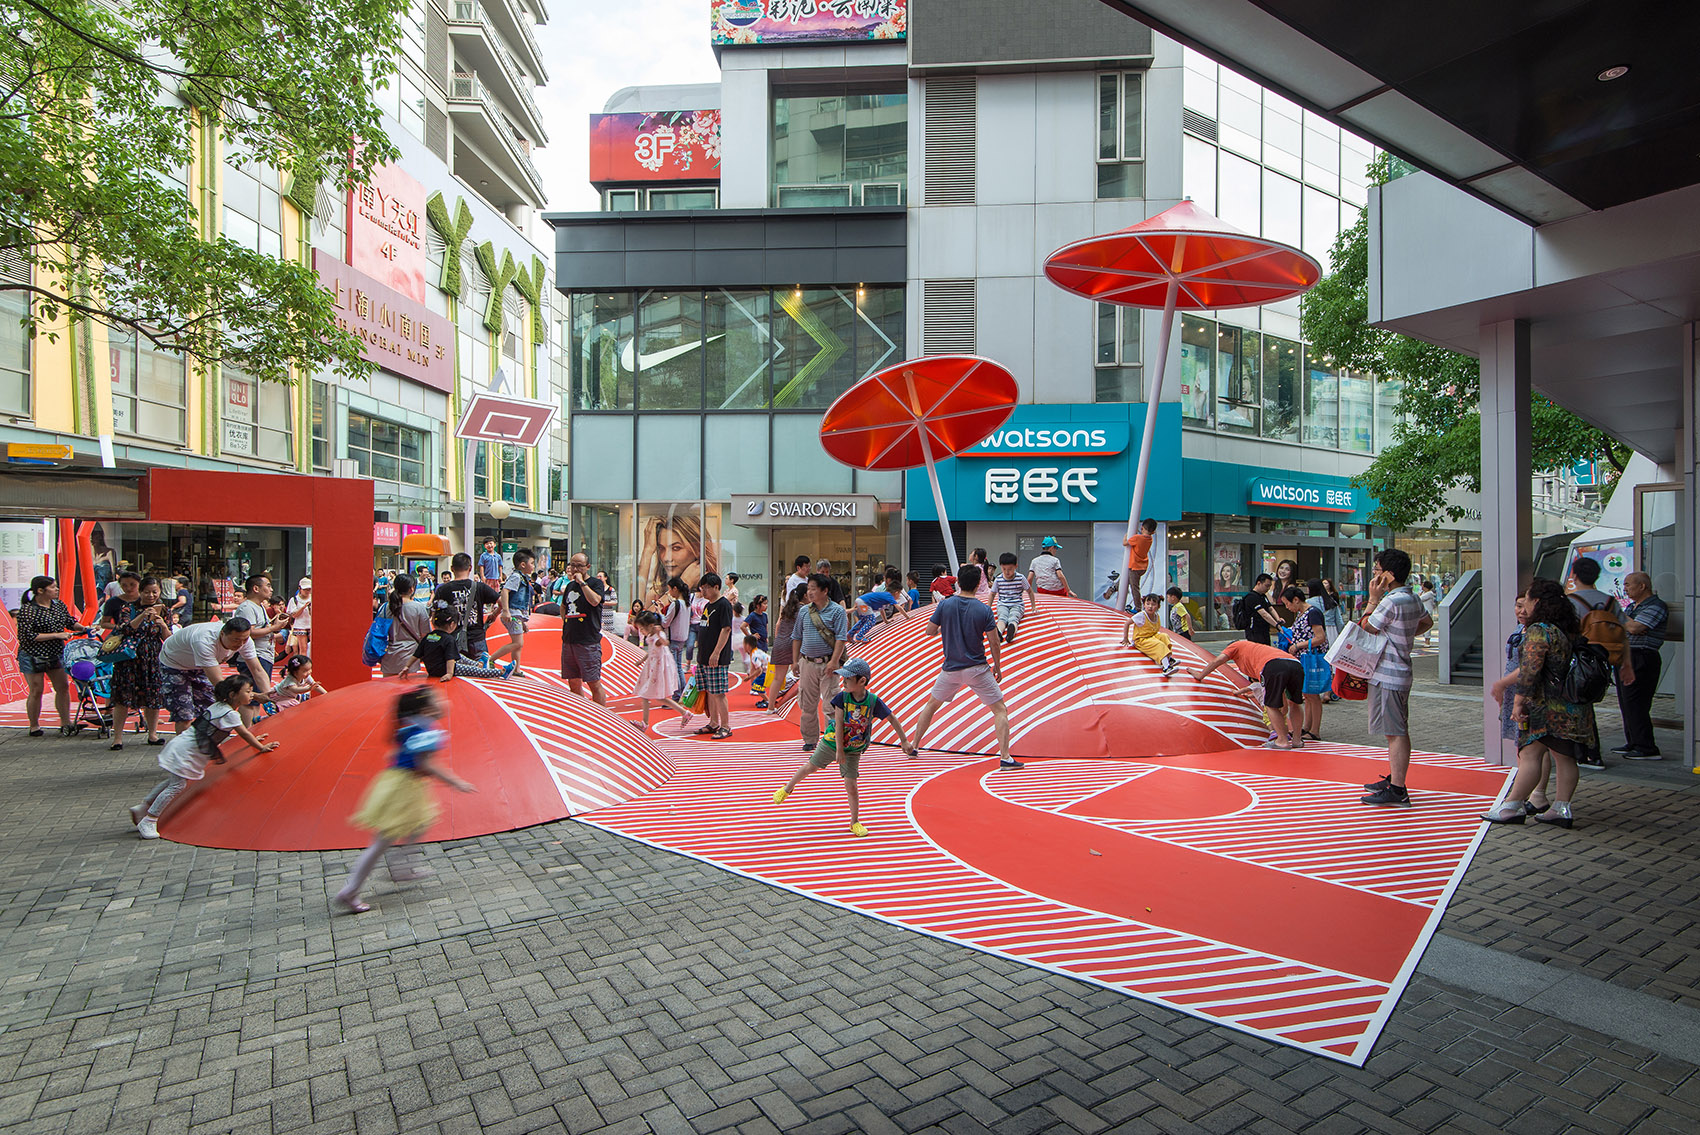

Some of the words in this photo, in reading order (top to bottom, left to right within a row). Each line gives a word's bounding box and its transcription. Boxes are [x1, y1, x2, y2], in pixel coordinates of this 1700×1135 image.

[636, 134, 675, 161] 3F
[359, 183, 420, 241] 南丫天虹
[380, 241, 398, 261] 4F
[333, 316, 401, 357] HANGHAI
[407, 348, 429, 368] MIN
[435, 344, 446, 360] 3F
[231, 382, 246, 394] UNI
[231, 393, 247, 404] QLO
[229, 429, 248, 440] 优衣库
[981, 428, 1106, 447] watsons
[985, 467, 1098, 504] 屈臣氏
[1260, 483, 1319, 503] watsons
[1326, 489, 1352, 506] 屈臣氏
[769, 502, 857, 517] SWAROVSKI
